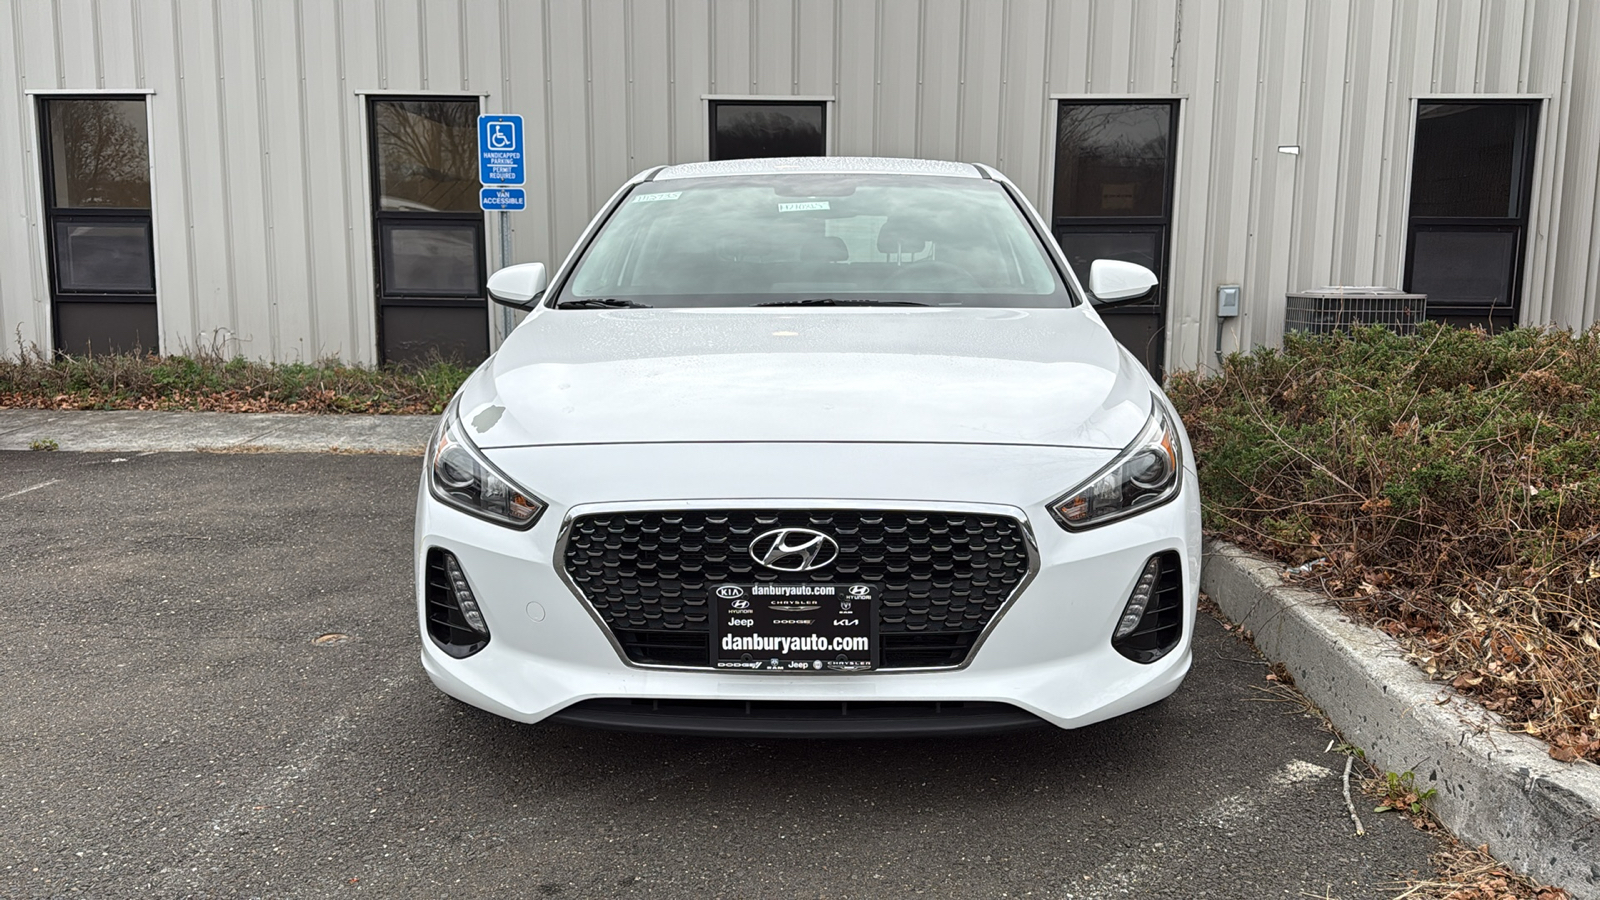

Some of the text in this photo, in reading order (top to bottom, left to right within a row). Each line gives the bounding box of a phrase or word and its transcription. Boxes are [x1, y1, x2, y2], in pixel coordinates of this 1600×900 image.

[752, 585, 835, 596] danburyauto.com
[728, 617, 754, 628] Jeep
[721, 633, 869, 655] danburyauto.com
[788, 660, 809, 670] Jeep
